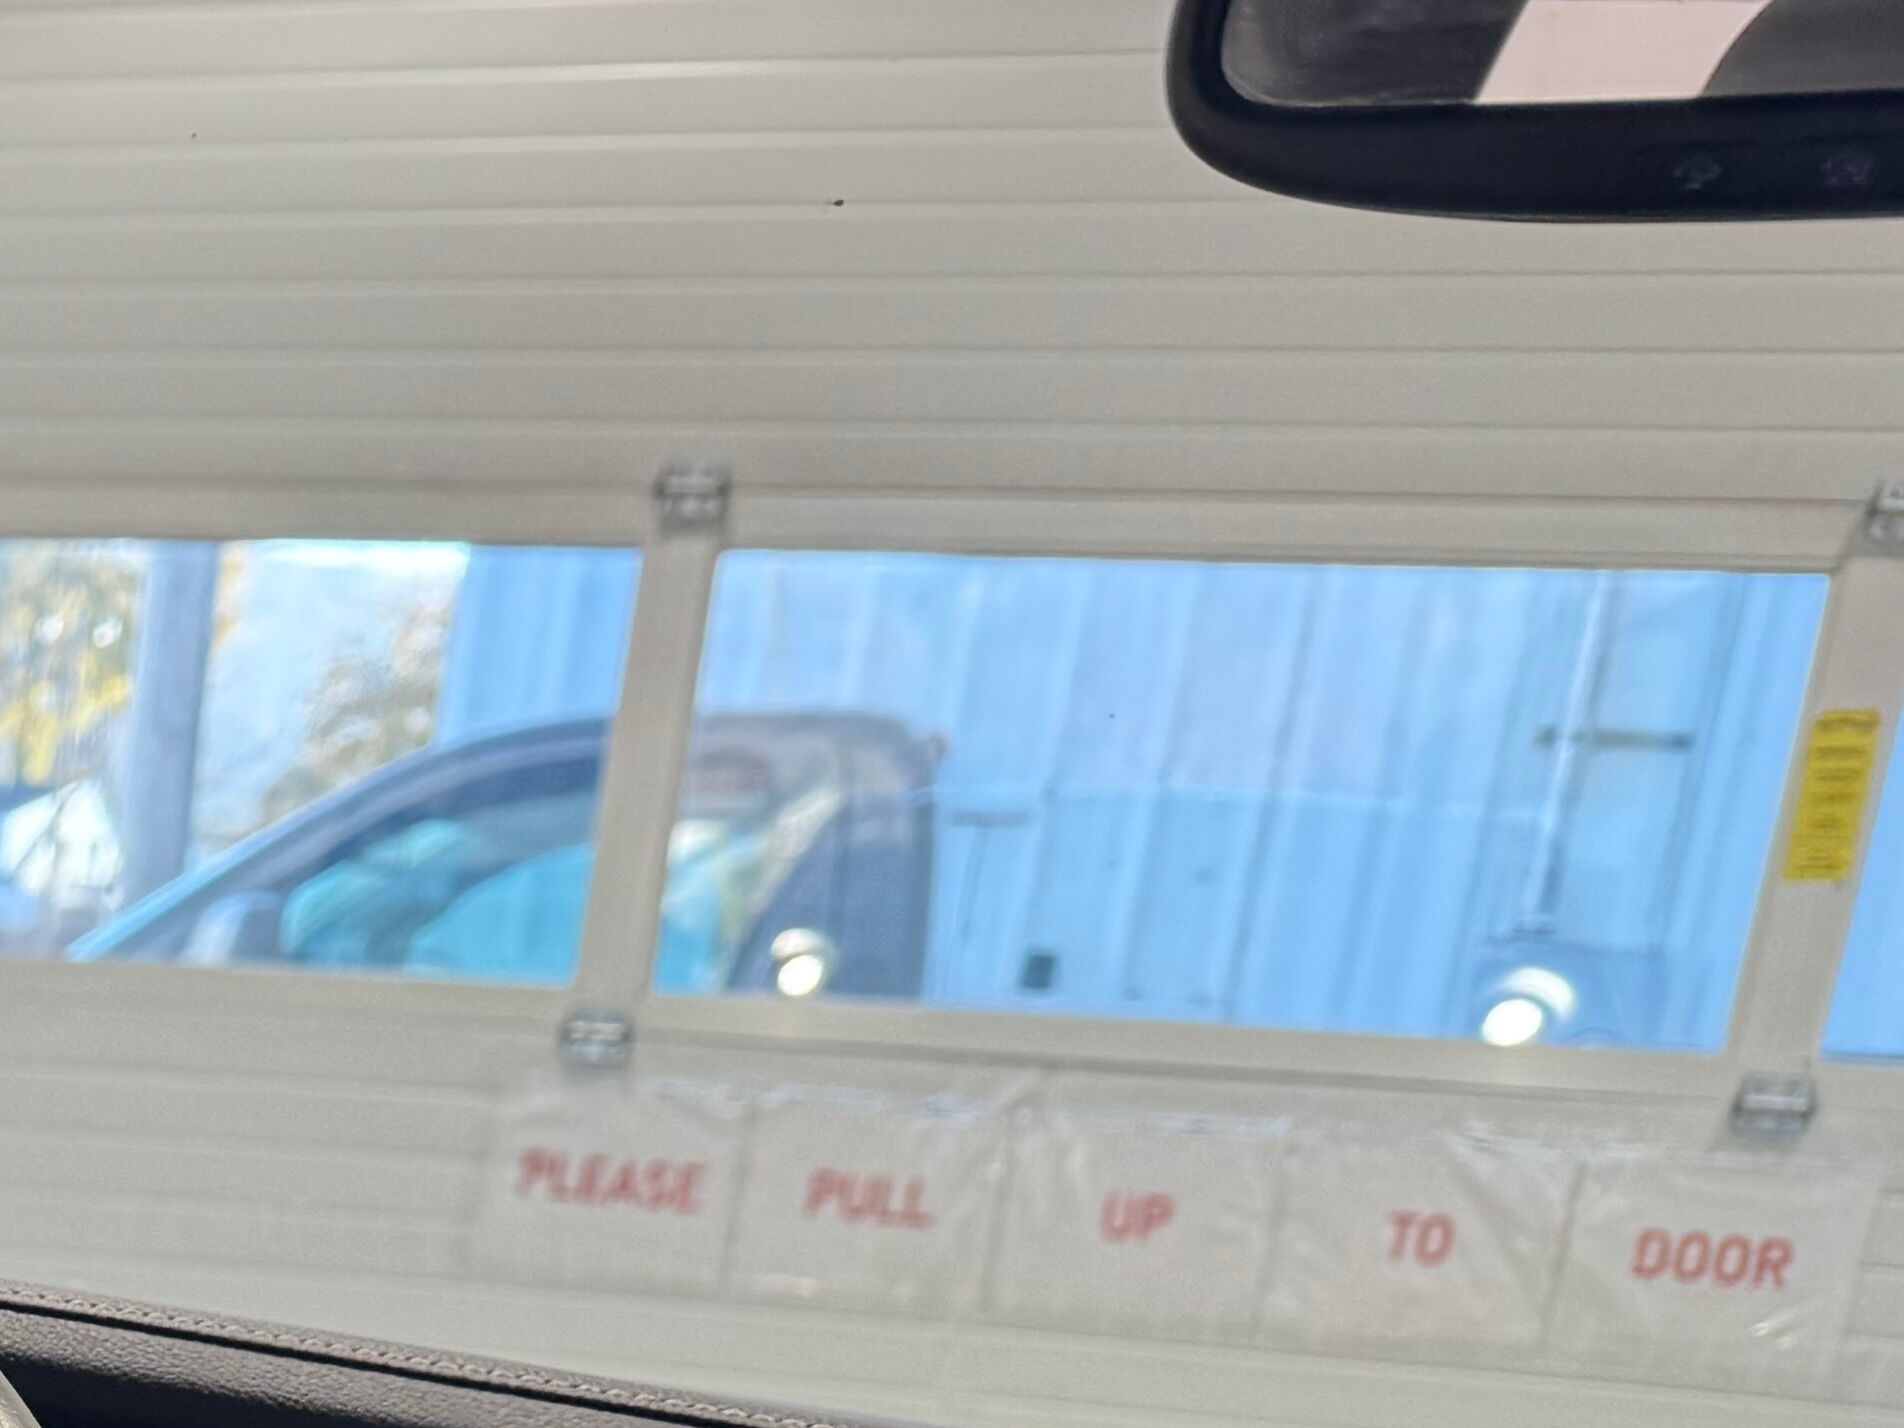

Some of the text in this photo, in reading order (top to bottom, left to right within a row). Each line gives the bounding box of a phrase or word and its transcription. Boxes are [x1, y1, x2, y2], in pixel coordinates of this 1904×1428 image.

[518, 1145, 1794, 1291] PLEASE PULL UP TO DOOR
